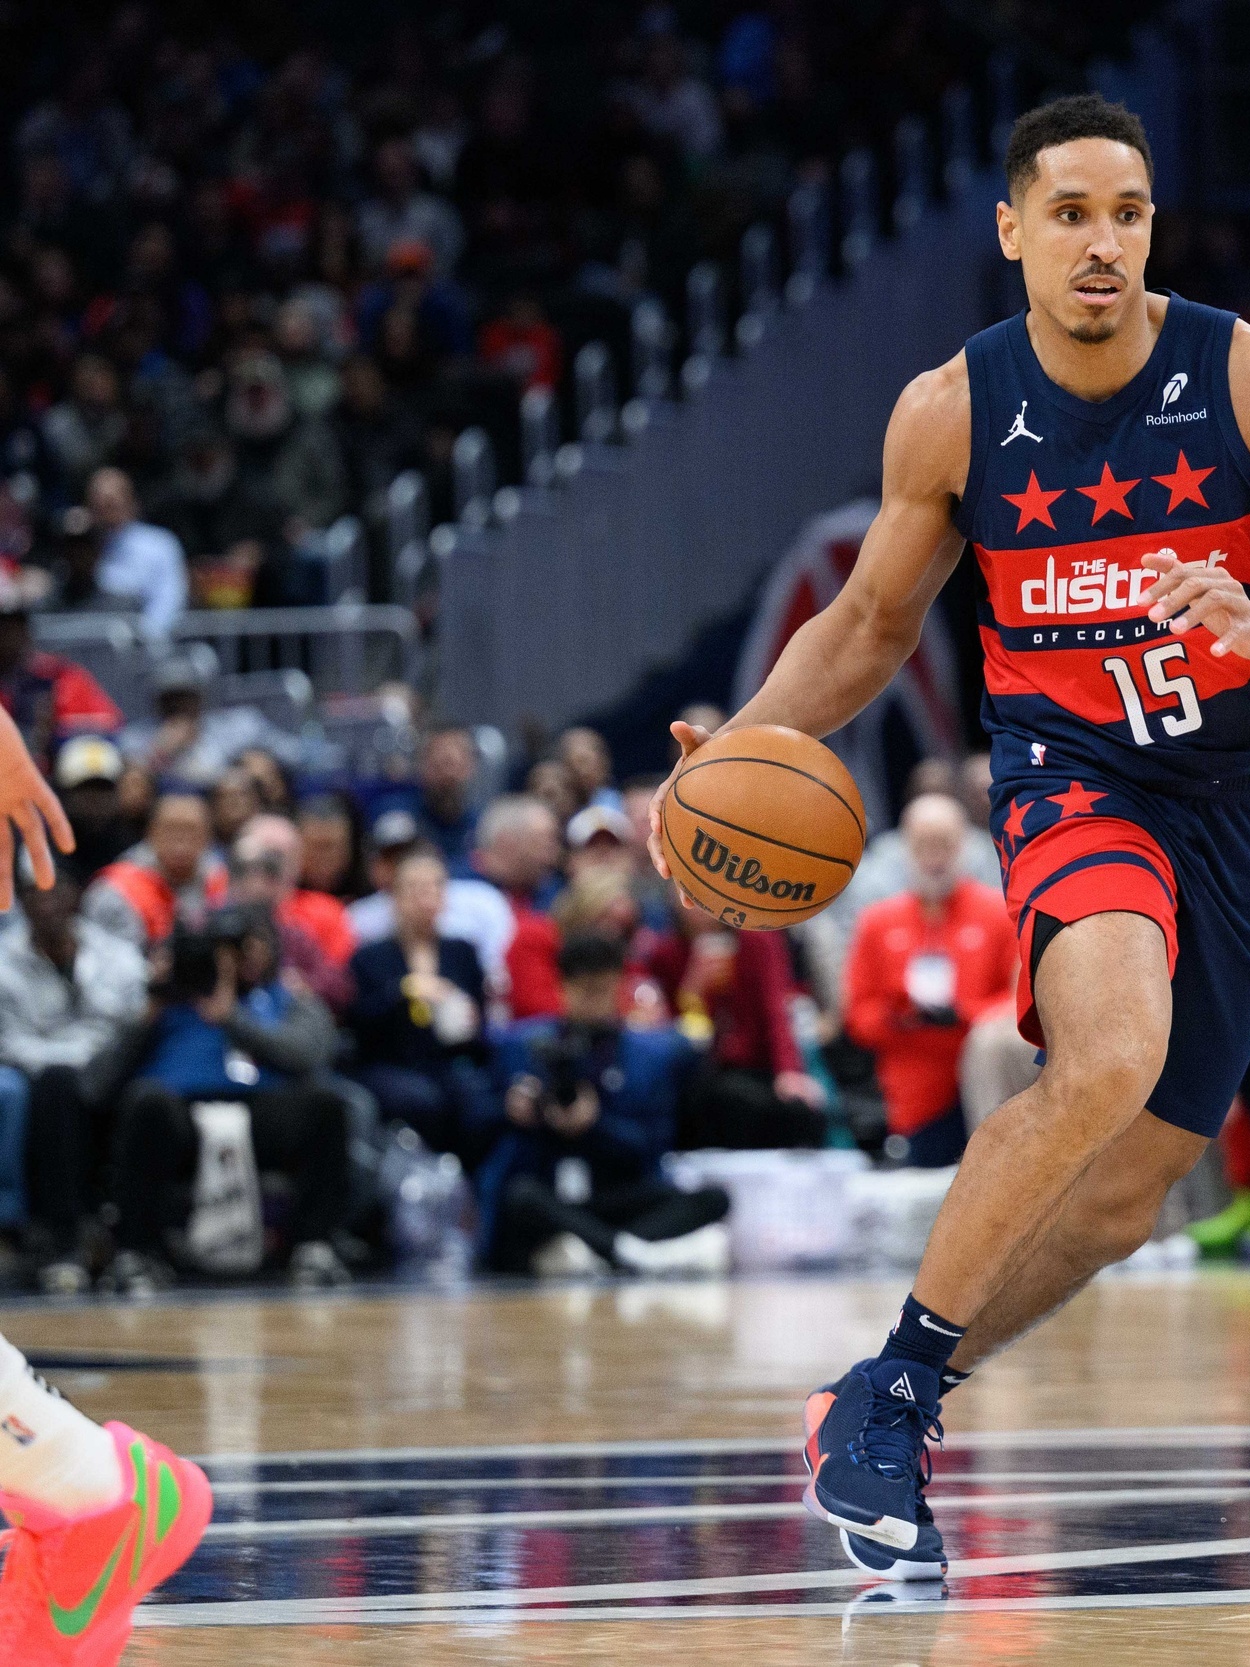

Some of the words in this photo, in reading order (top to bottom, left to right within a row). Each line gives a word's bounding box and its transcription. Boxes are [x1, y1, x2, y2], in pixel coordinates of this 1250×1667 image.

[1145, 407, 1207, 426] Robinhood
[1070, 558, 1107, 576] THE
[1033, 631, 1059, 644] OF
[1103, 641, 1204, 747] 15
[690, 825, 817, 902] Wilson
